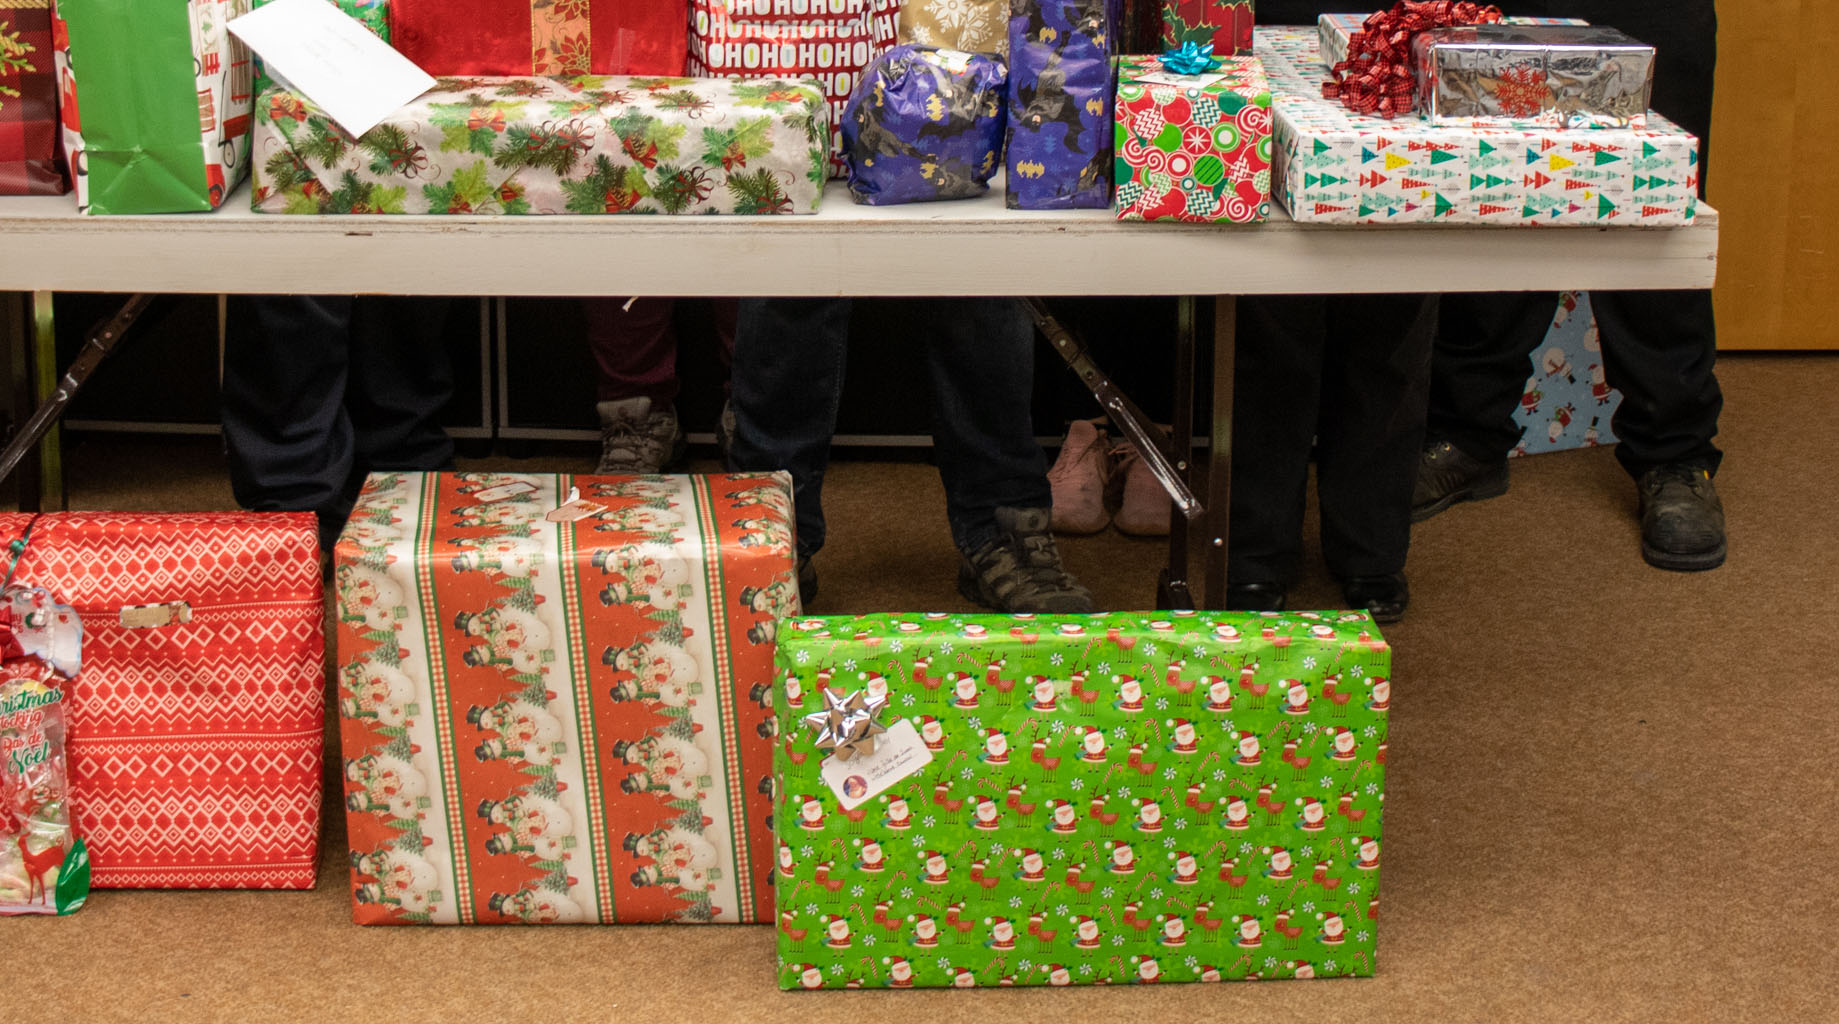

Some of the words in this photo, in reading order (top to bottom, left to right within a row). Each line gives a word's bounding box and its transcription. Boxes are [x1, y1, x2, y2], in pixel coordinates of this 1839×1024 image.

[0, 688, 63, 714] ristmas
[28, 729, 43, 745] de
[8, 741, 48, 774] Noël
